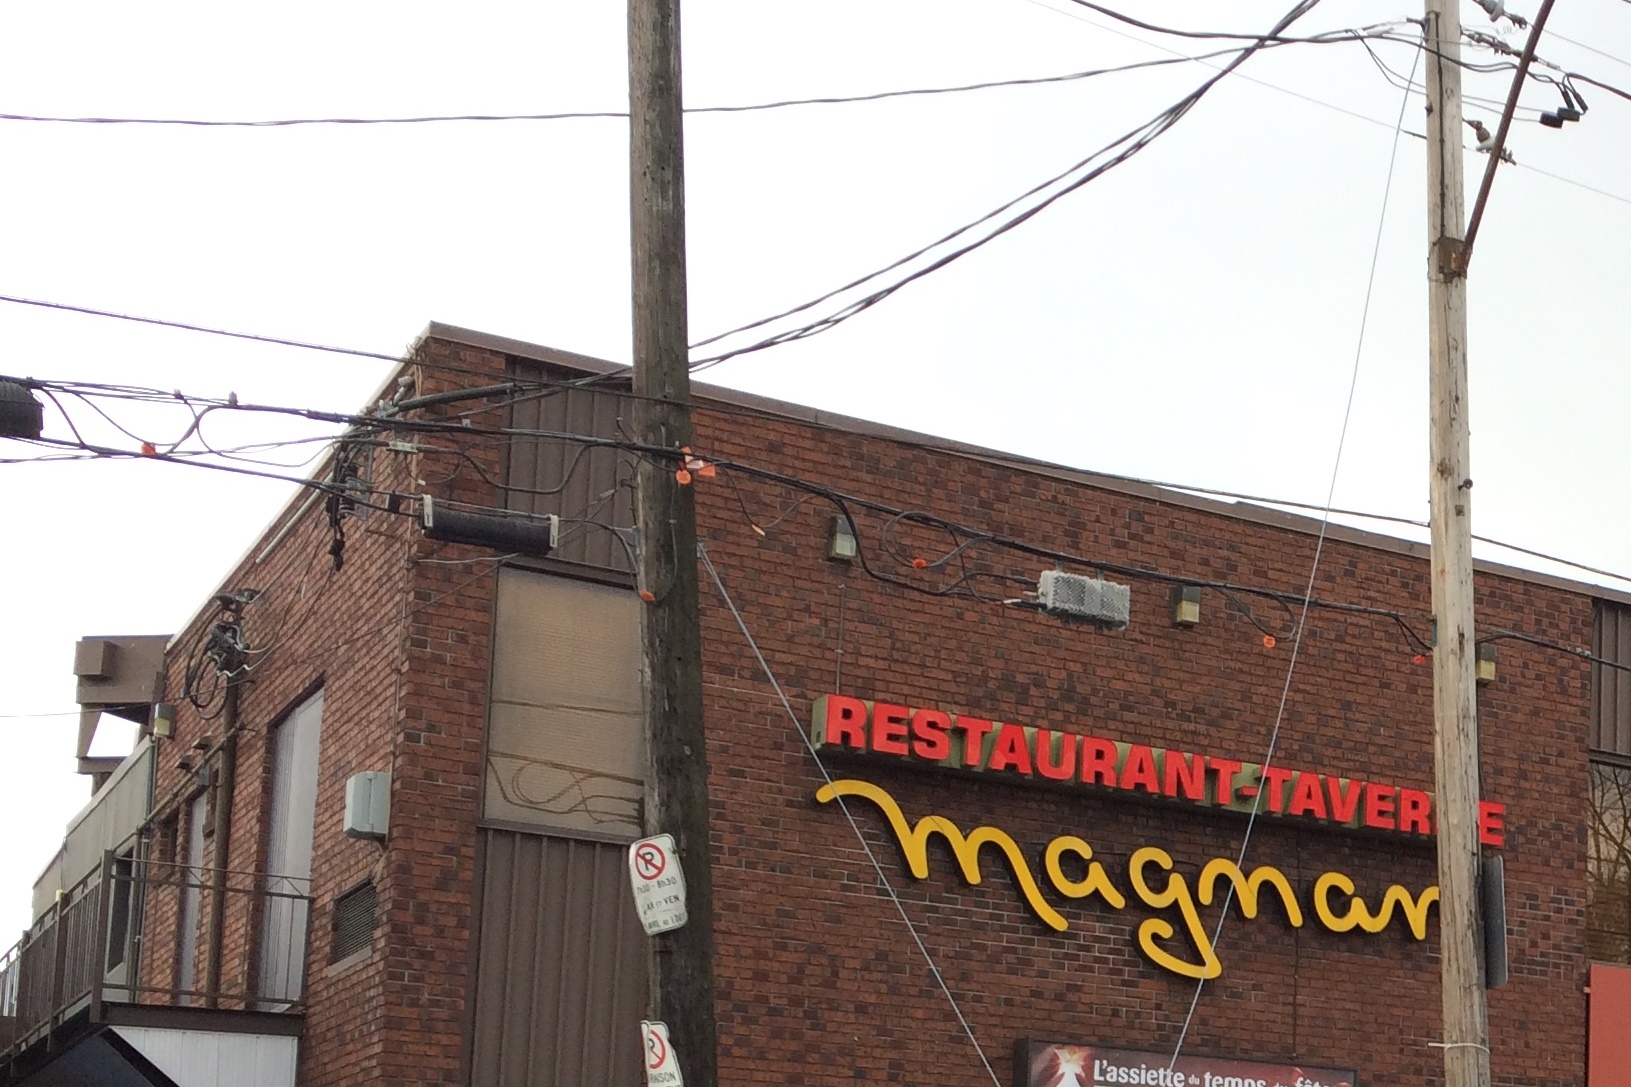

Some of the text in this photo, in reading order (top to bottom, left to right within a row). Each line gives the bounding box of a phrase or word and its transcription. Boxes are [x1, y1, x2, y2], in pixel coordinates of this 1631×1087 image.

[826, 694, 1505, 846] RESTAURANT-TAVERE
[663, 894, 680, 905] VEN
[1094, 1060, 1185, 1087] L'assiette
[1189, 1074, 1200, 1085] du
